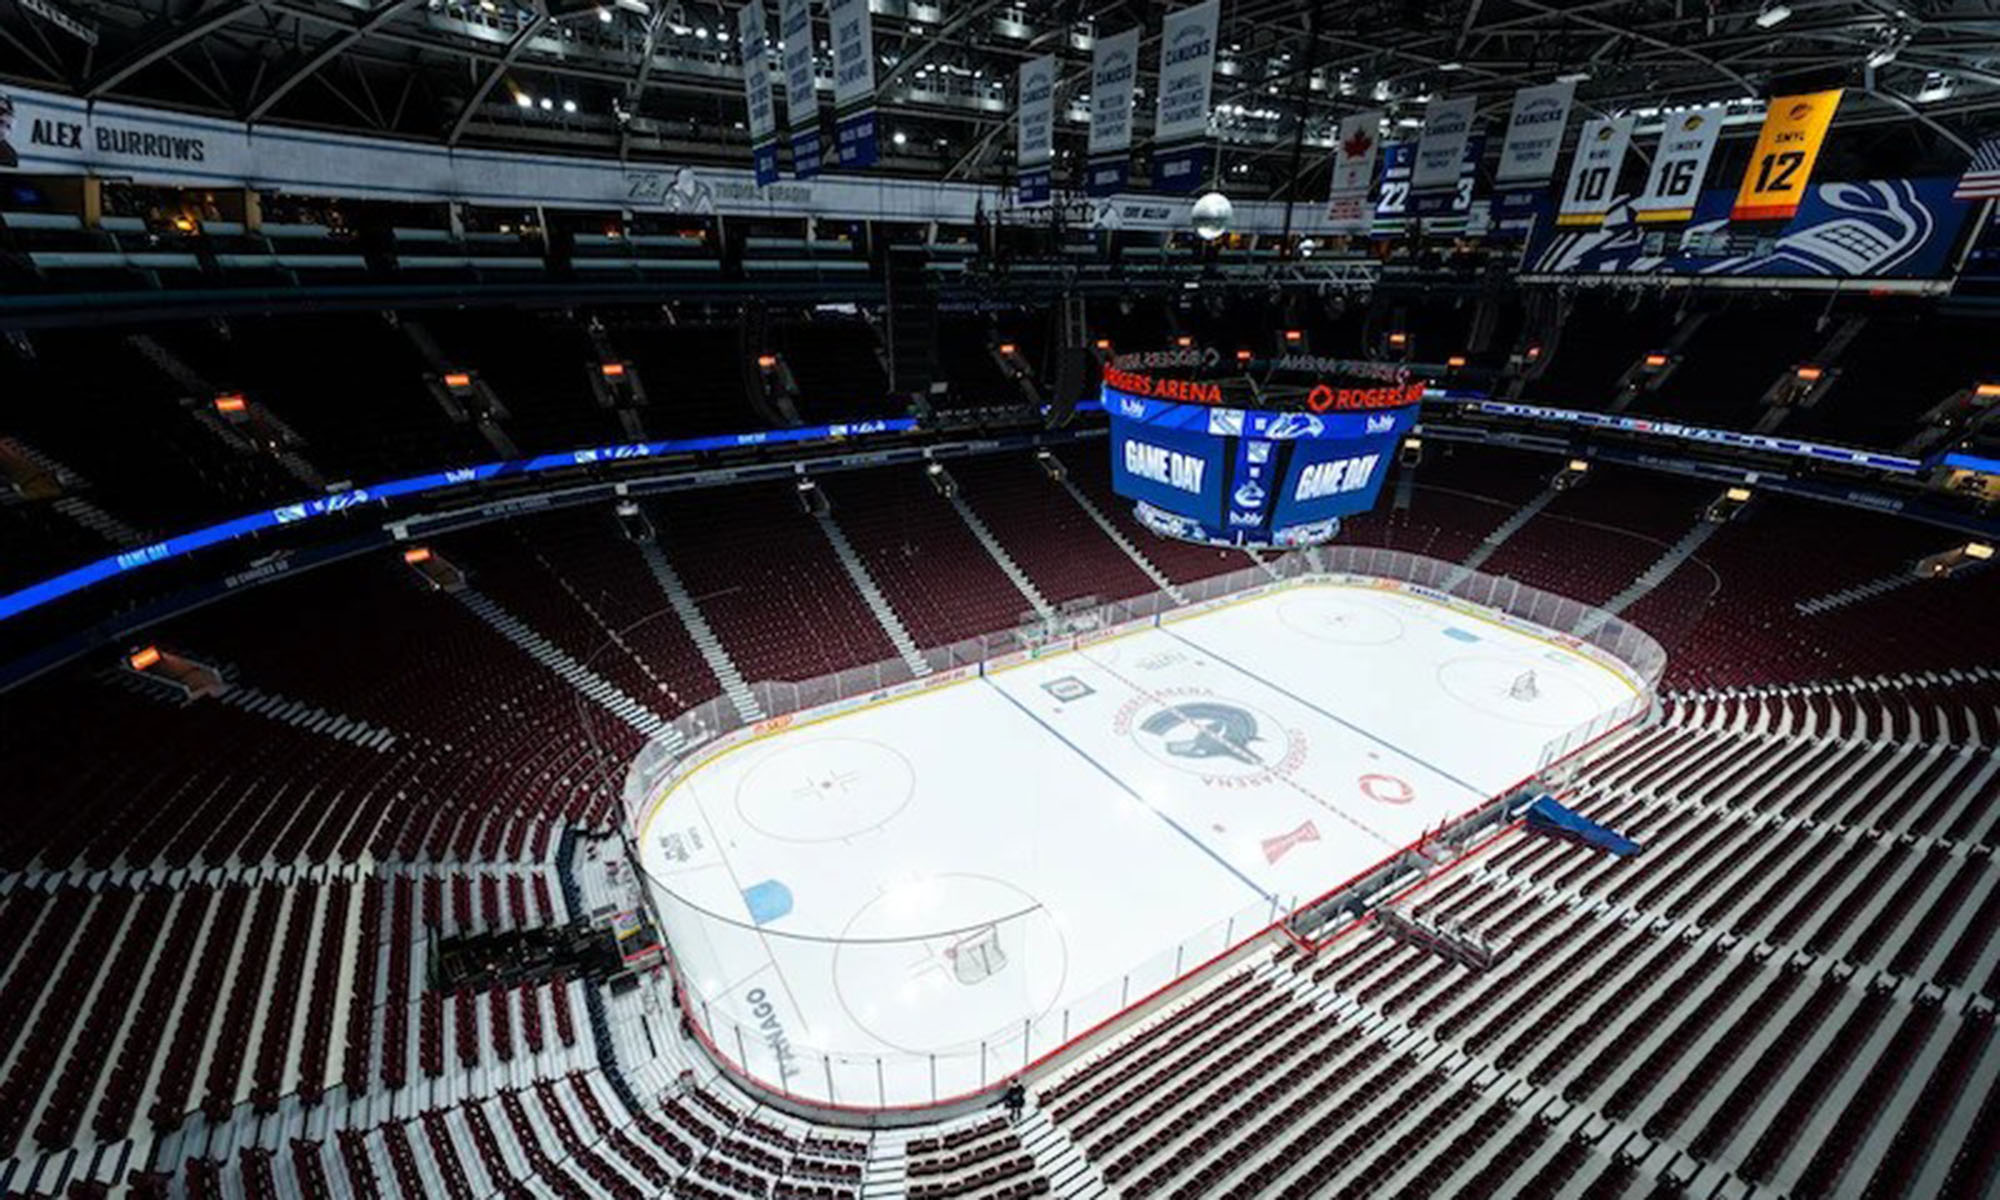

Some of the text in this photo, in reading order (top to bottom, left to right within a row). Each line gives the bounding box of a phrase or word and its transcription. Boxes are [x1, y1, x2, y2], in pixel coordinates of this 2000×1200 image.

[1165, 39, 1210, 66] CANUCKS
[1514, 109, 1563, 126] CANUCKS
[31, 118, 204, 162] ALEX BURROWS
[1574, 167, 1611, 202] 10
[1655, 159, 1698, 197] 16
[1755, 151, 1806, 193] 12
[1376, 181, 1410, 213] 22
[1452, 177, 1475, 210] 3
[1154, 379, 1222, 402] ARENA
[1336, 388, 1402, 409] ROGERS
[1124, 440, 1205, 494] GAME DAY
[1295, 453, 1380, 501] GAME DAY
